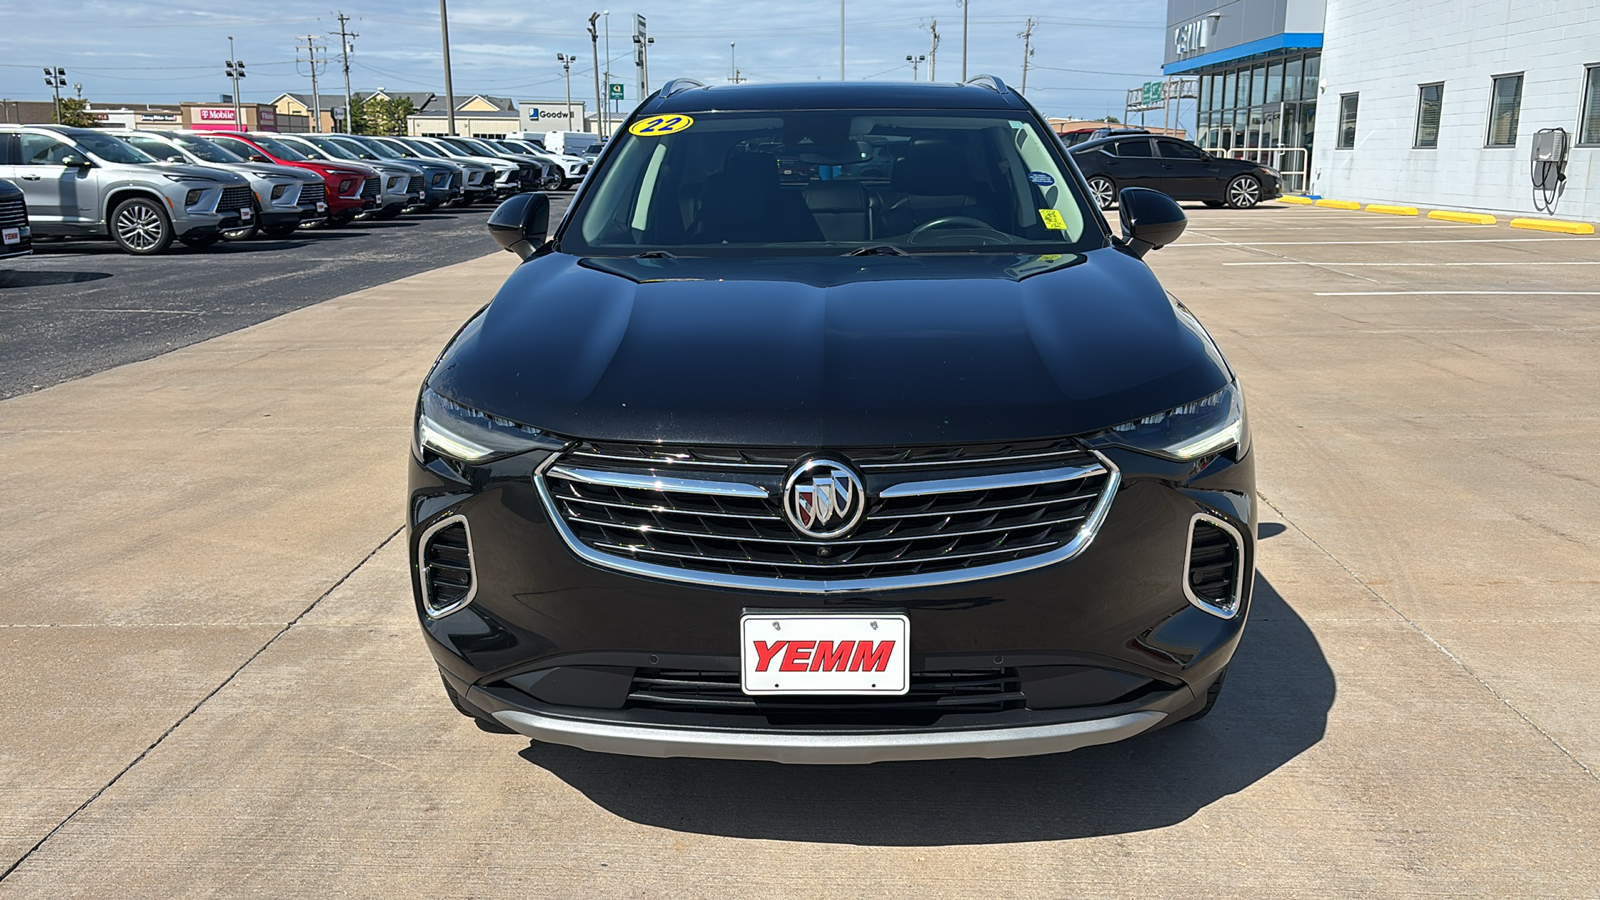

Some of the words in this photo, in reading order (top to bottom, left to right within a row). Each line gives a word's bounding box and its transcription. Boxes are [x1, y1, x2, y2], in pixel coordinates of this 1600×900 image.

[539, 110, 575, 119] Goodwll
[639, 117, 682, 133] 22
[753, 640, 896, 672] YEMM
